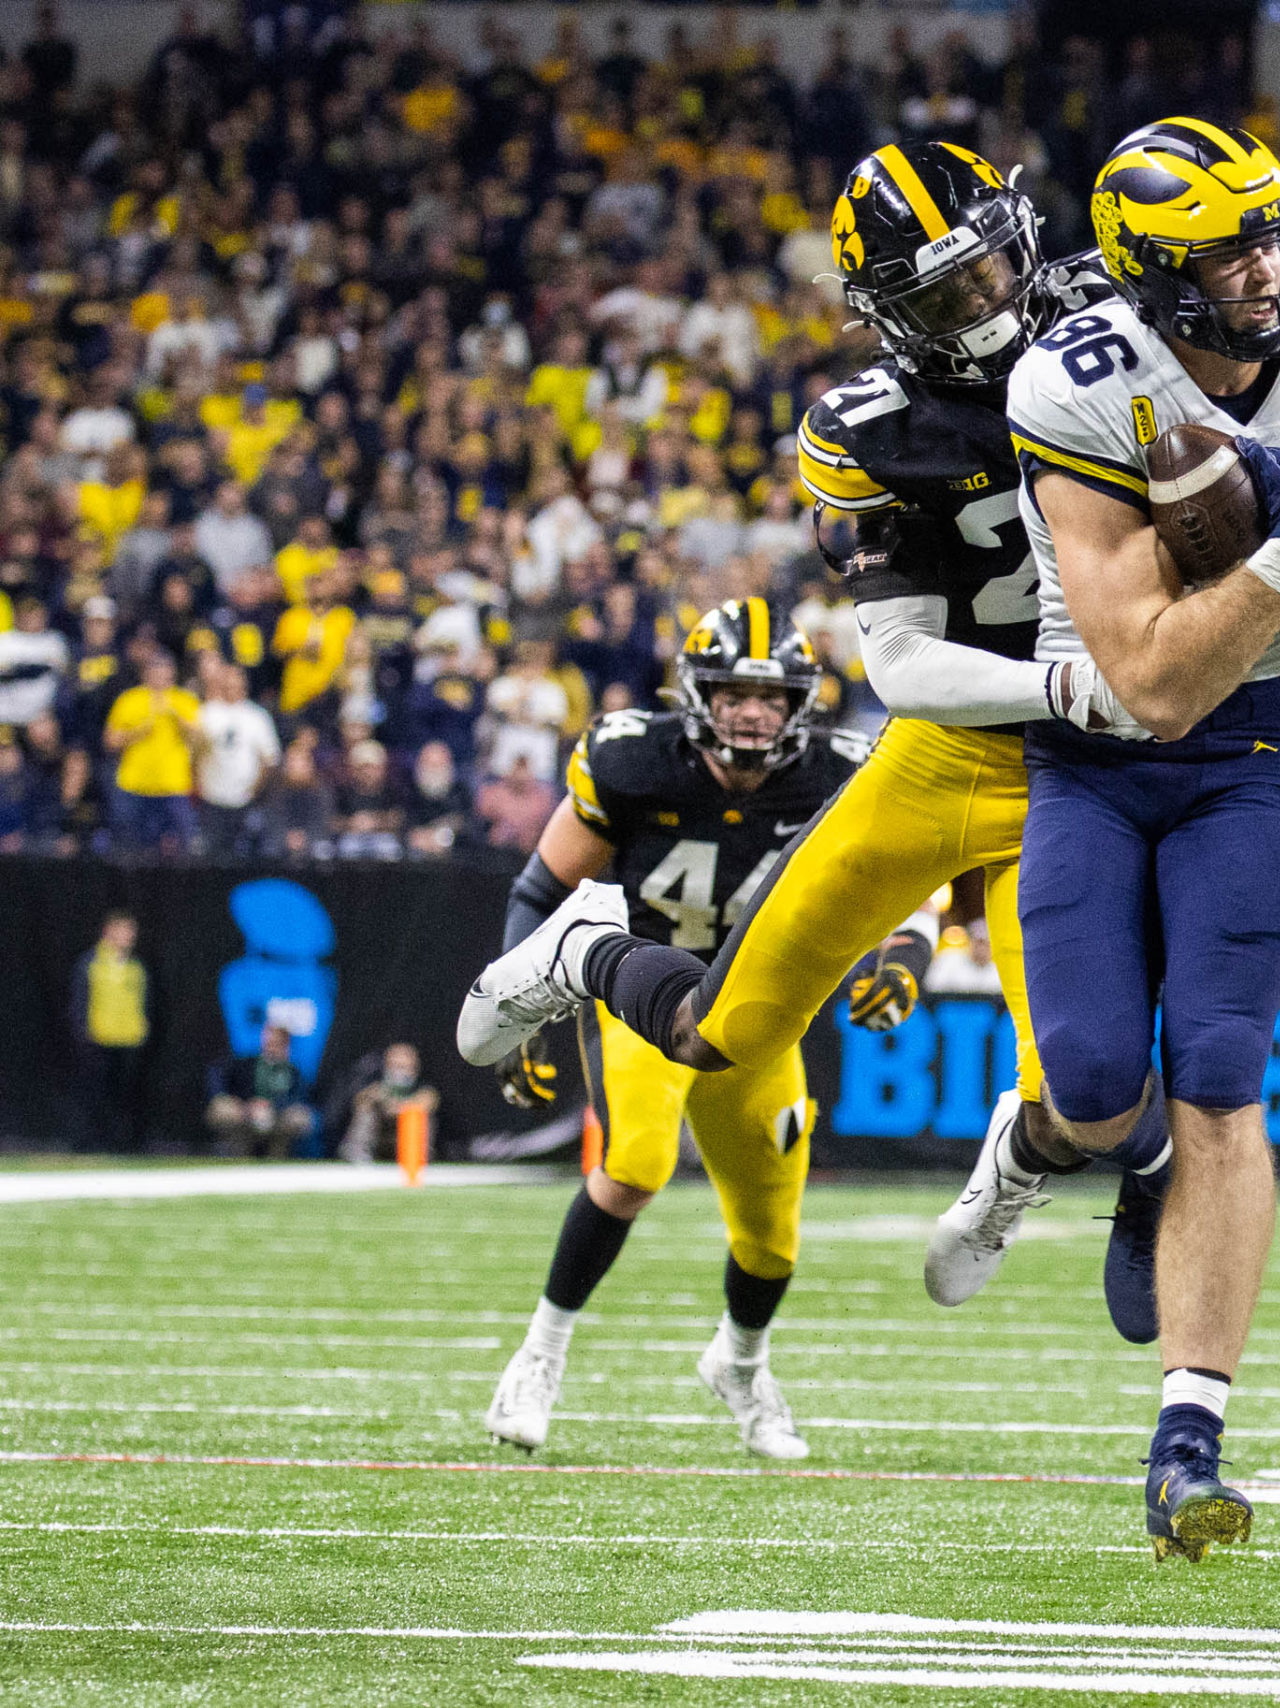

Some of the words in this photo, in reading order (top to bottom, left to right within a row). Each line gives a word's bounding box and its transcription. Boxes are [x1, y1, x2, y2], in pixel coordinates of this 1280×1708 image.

[930, 234, 960, 255] IOWA
[1034, 315, 1140, 388] 86
[820, 367, 911, 428] 27
[831, 998, 1021, 1140] BI
